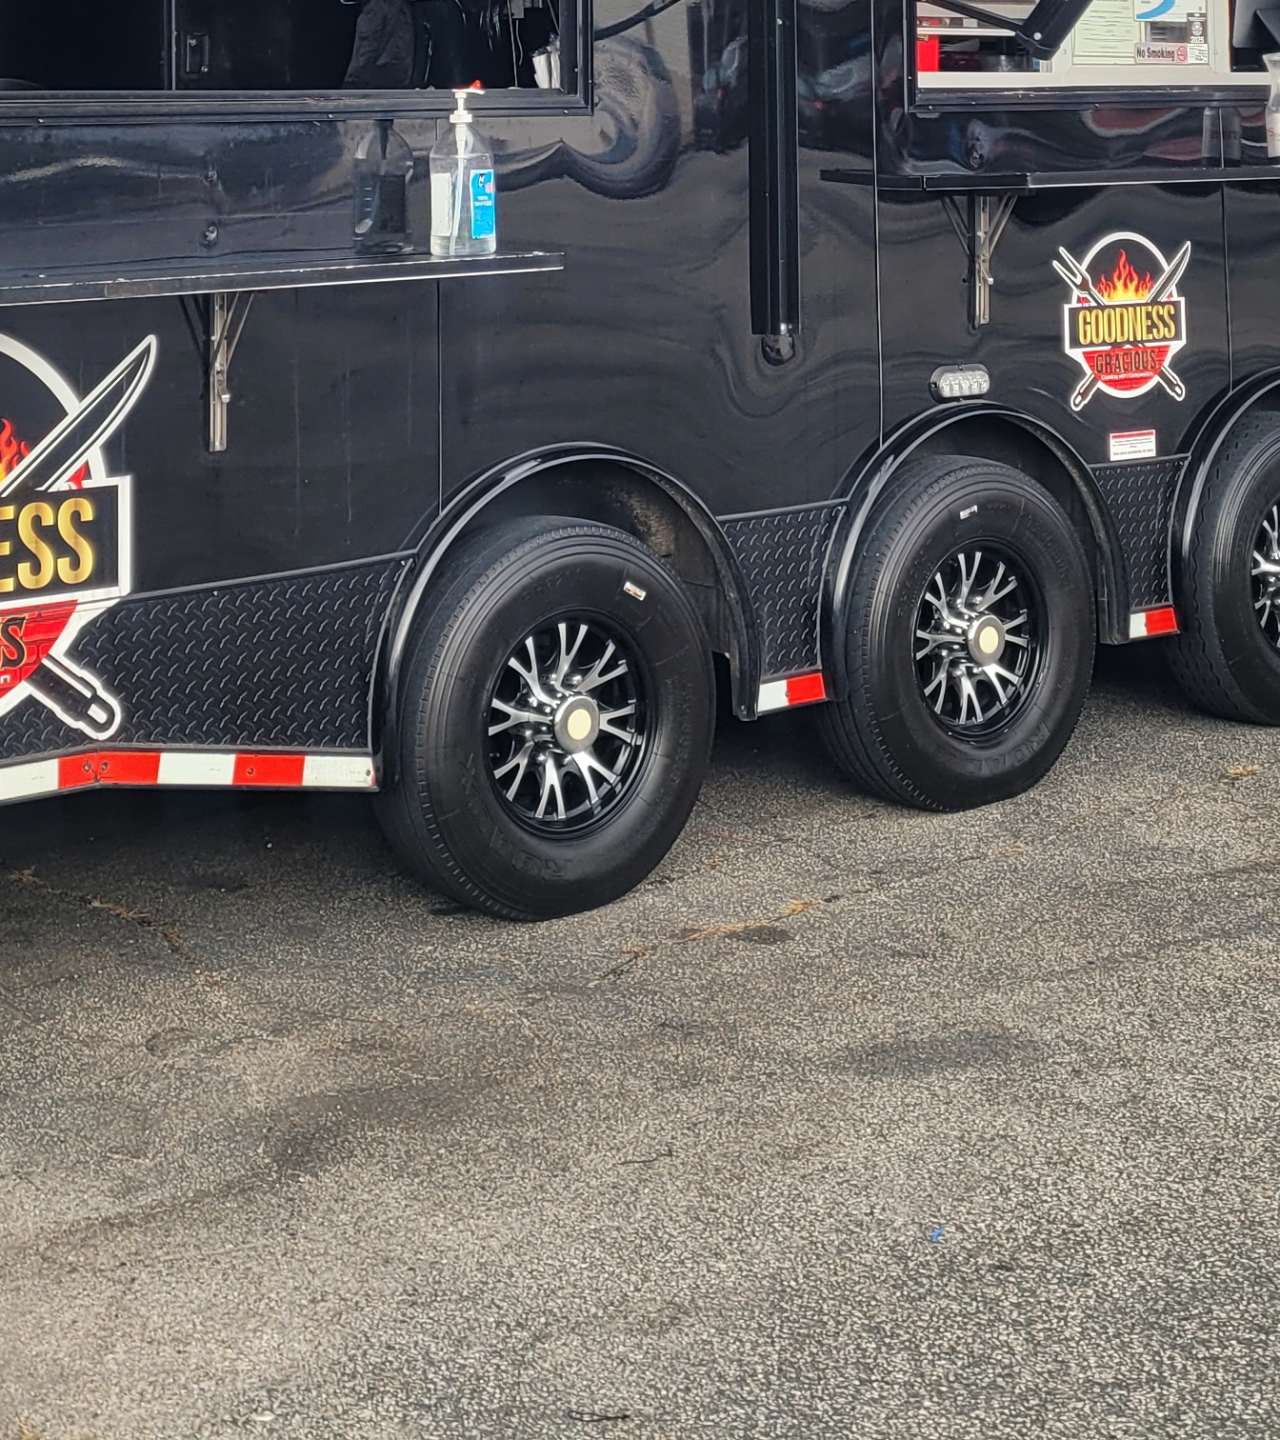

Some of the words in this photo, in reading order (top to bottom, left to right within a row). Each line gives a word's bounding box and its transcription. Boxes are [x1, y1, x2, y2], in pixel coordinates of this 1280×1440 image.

[1136, 47, 1146, 58] No
[1147, 47, 1175, 61] Smoking
[1079, 304, 1176, 345] GOODNESS
[1095, 350, 1157, 373] GRACIOUS
